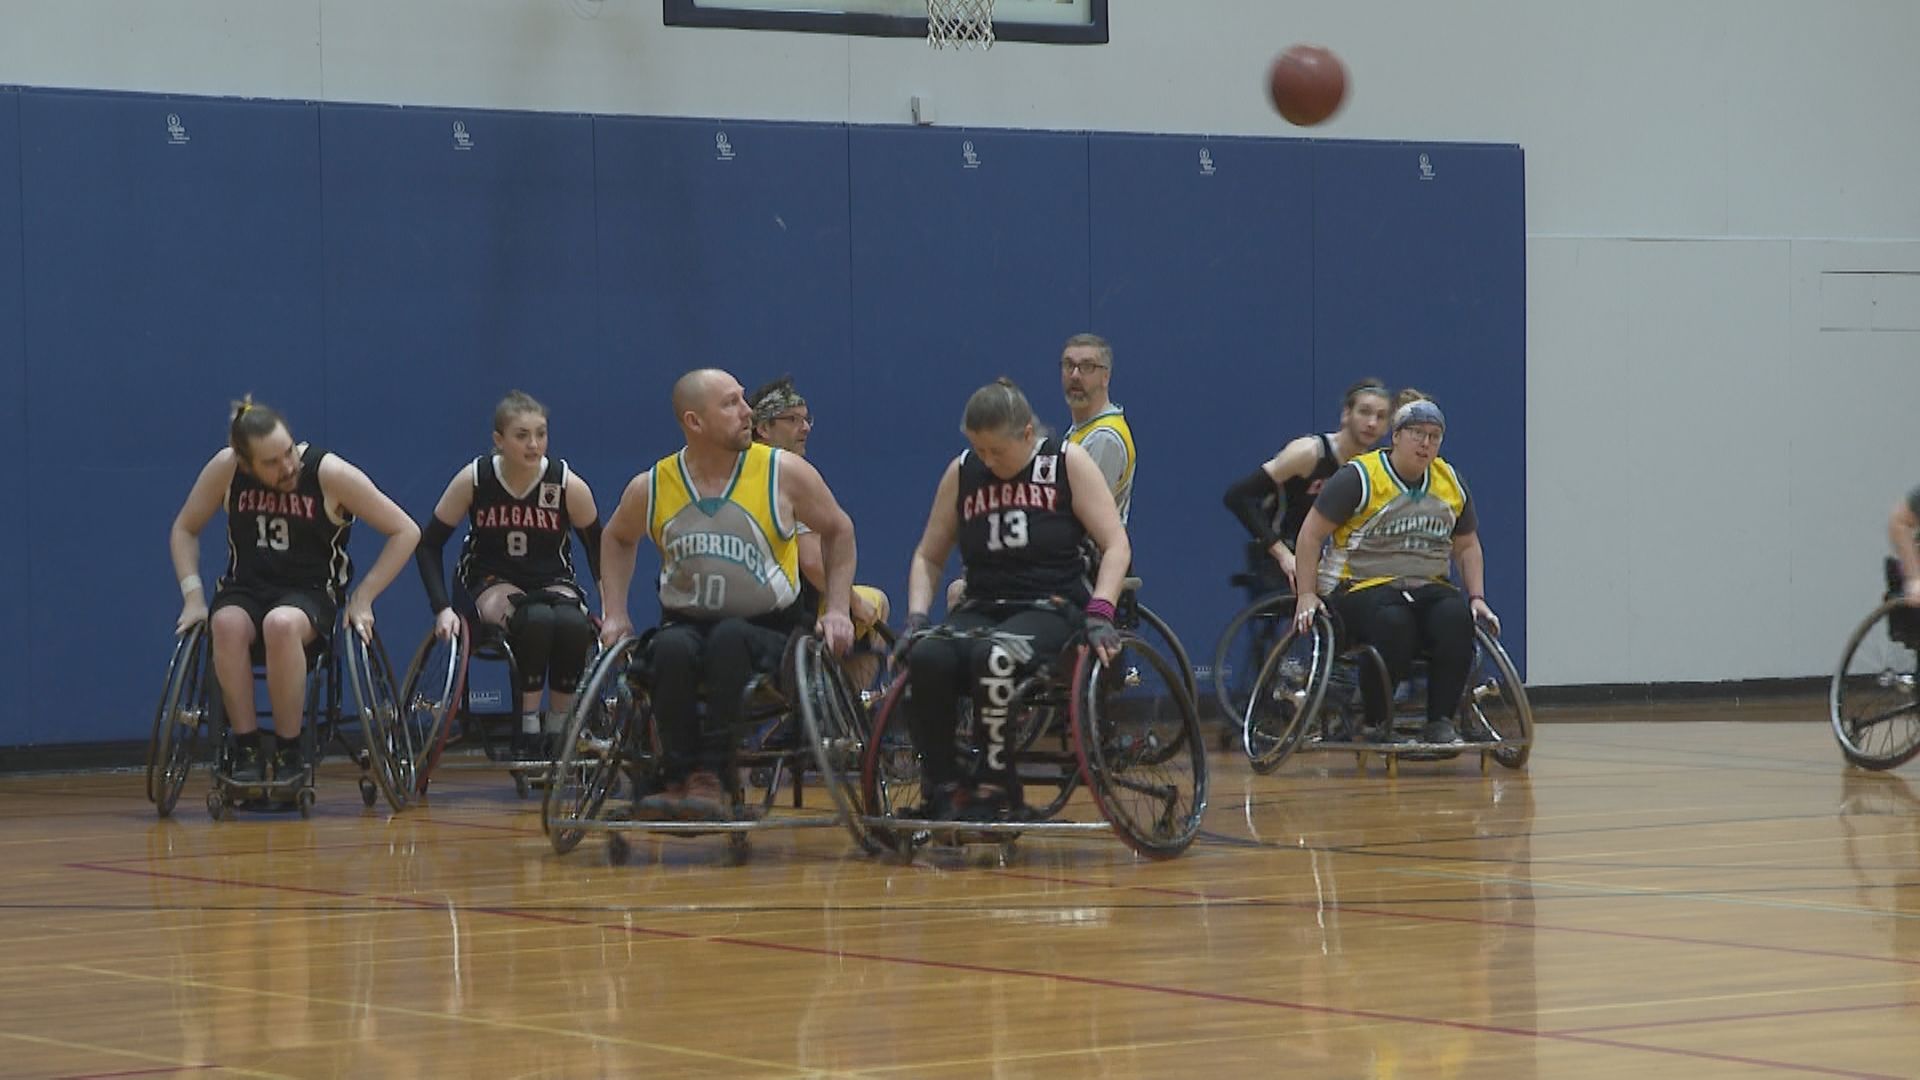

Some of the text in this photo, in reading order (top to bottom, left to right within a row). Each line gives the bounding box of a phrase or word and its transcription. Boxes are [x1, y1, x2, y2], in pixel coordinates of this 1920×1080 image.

[238, 489, 314, 519] CALGARY
[476, 504, 559, 531] CALGARY
[963, 482, 1057, 521] CALGARY
[256, 515, 290, 551] 13
[507, 531, 527, 556] 8
[987, 510, 1028, 551] 13
[666, 532, 767, 585] THBRIDGE
[688, 573, 726, 610] 10
[980, 636, 1020, 770] adida
